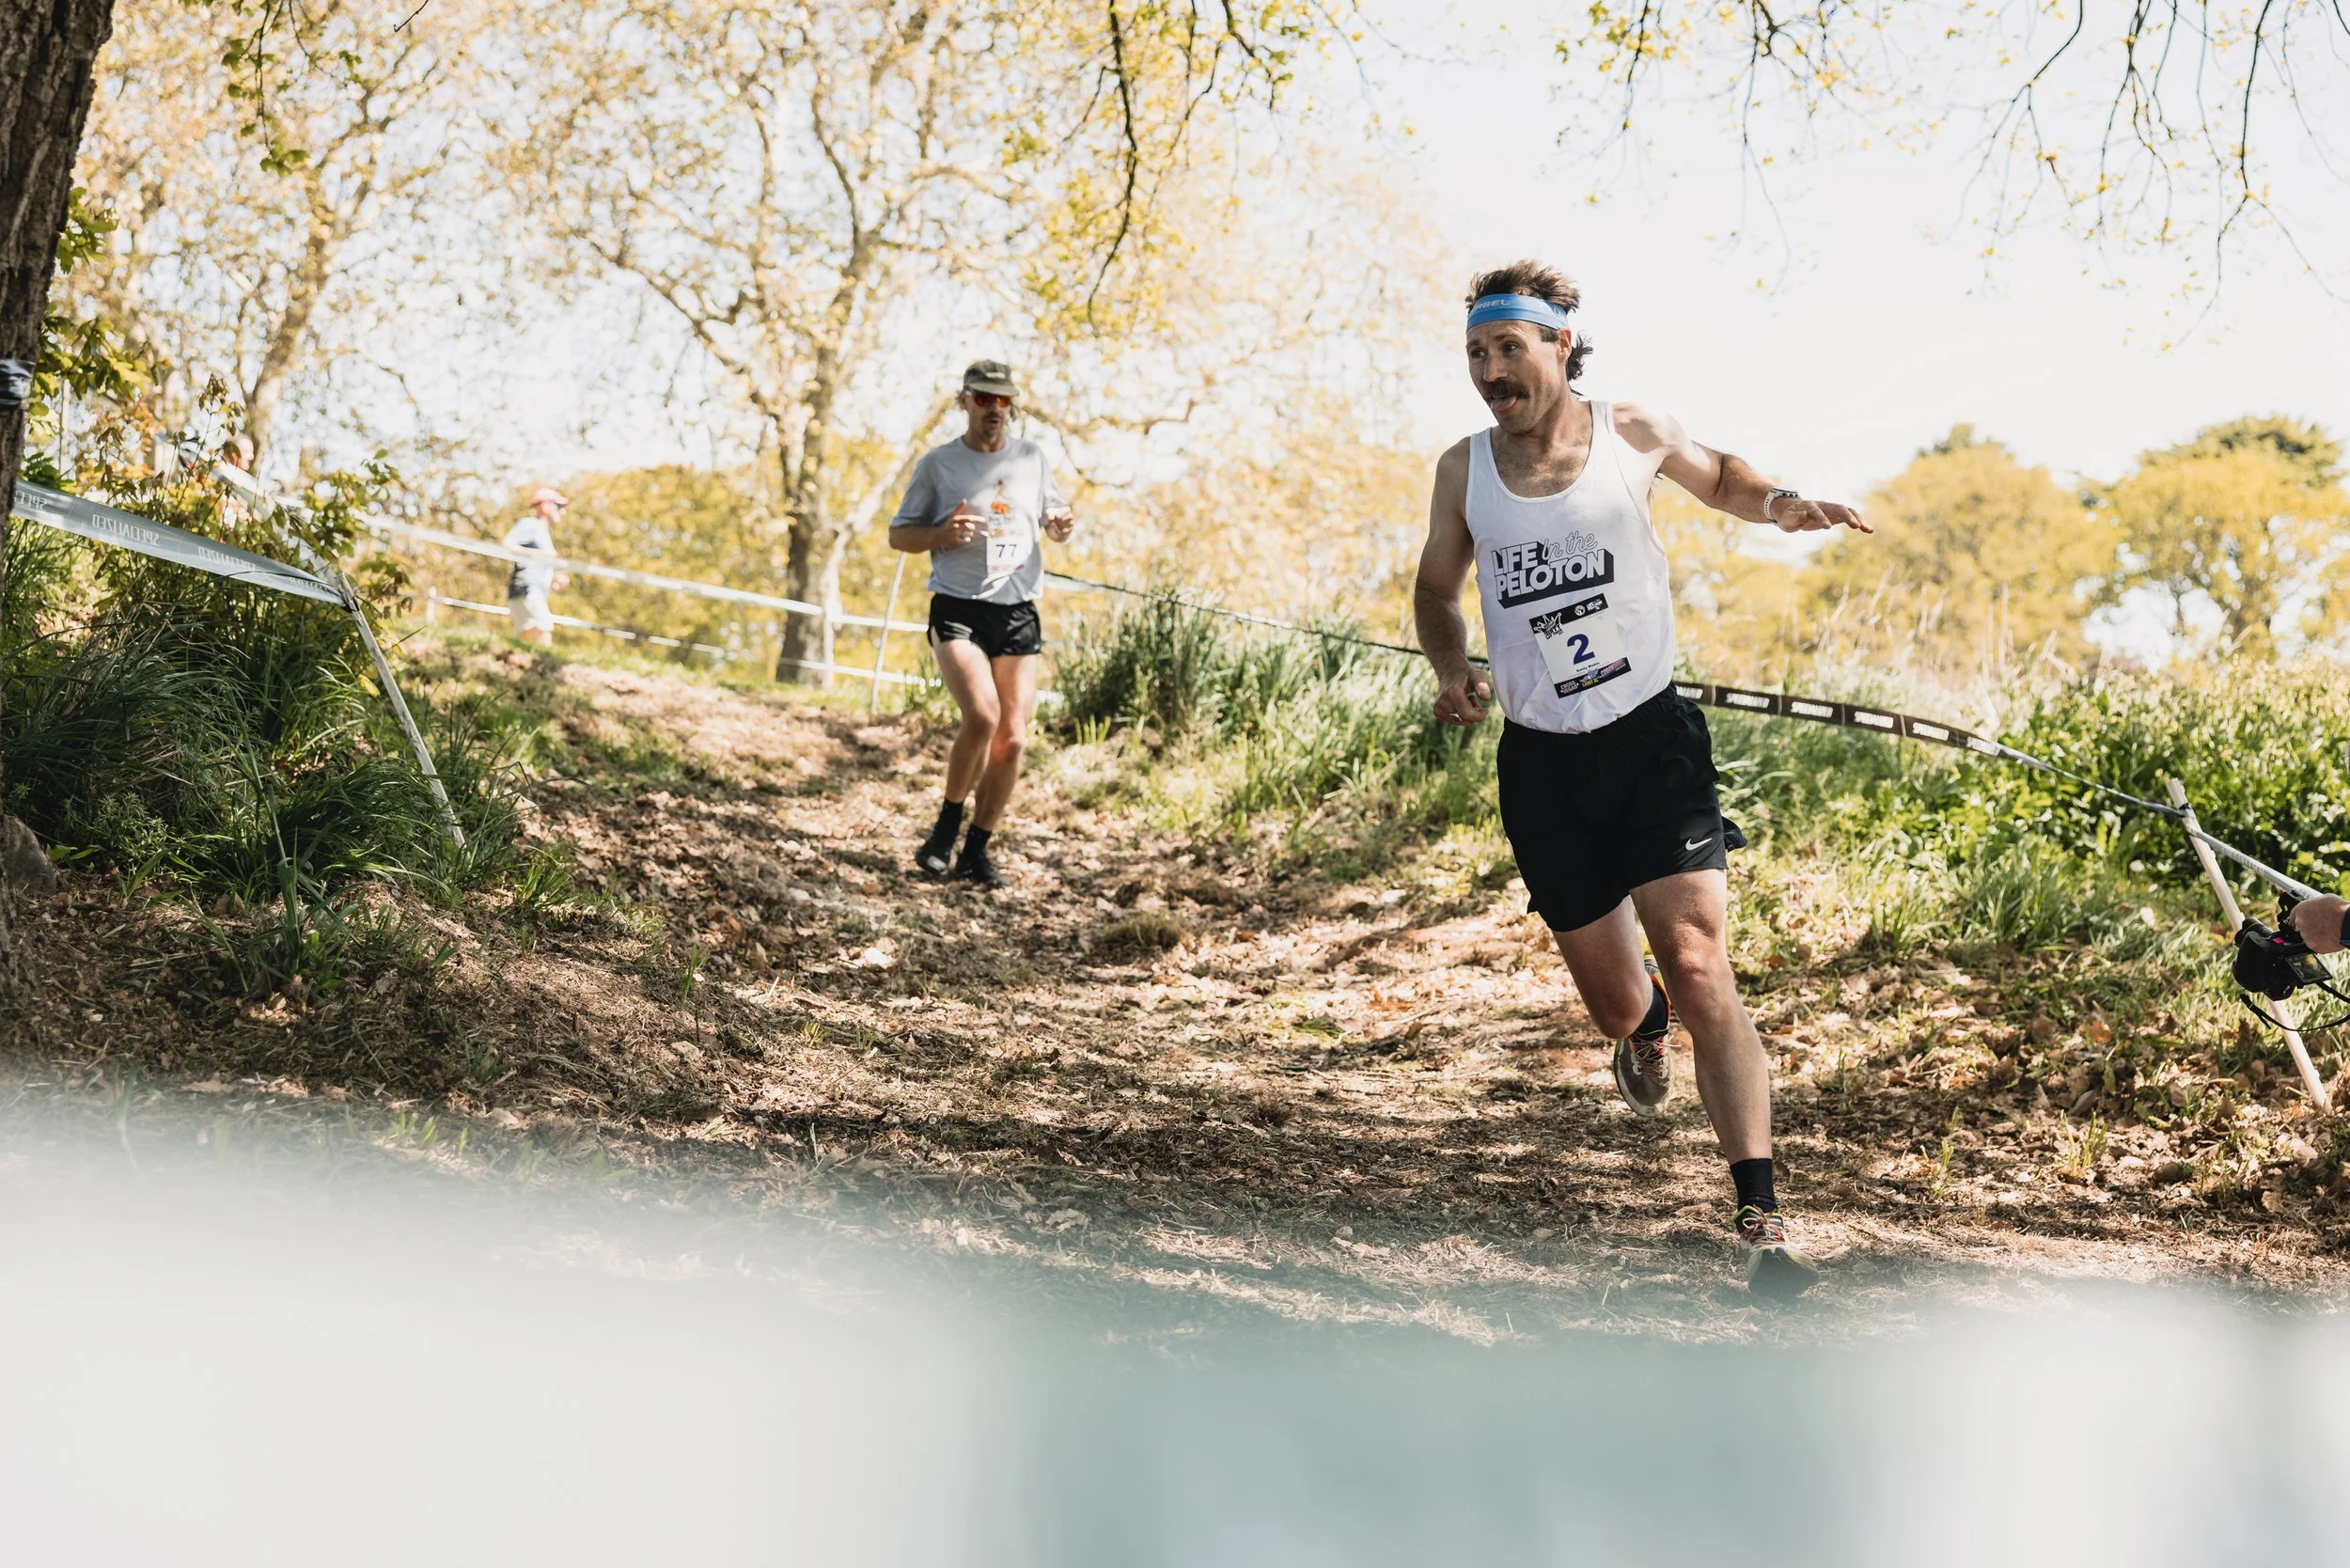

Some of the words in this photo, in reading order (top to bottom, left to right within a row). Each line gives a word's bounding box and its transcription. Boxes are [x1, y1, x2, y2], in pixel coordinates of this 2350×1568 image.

[996, 543, 1017, 557] 77
[1491, 541, 1540, 577] LIFE
[1565, 530, 1598, 555] the
[1496, 548, 1606, 601] PELOTON
[1567, 633, 1596, 665] 2
